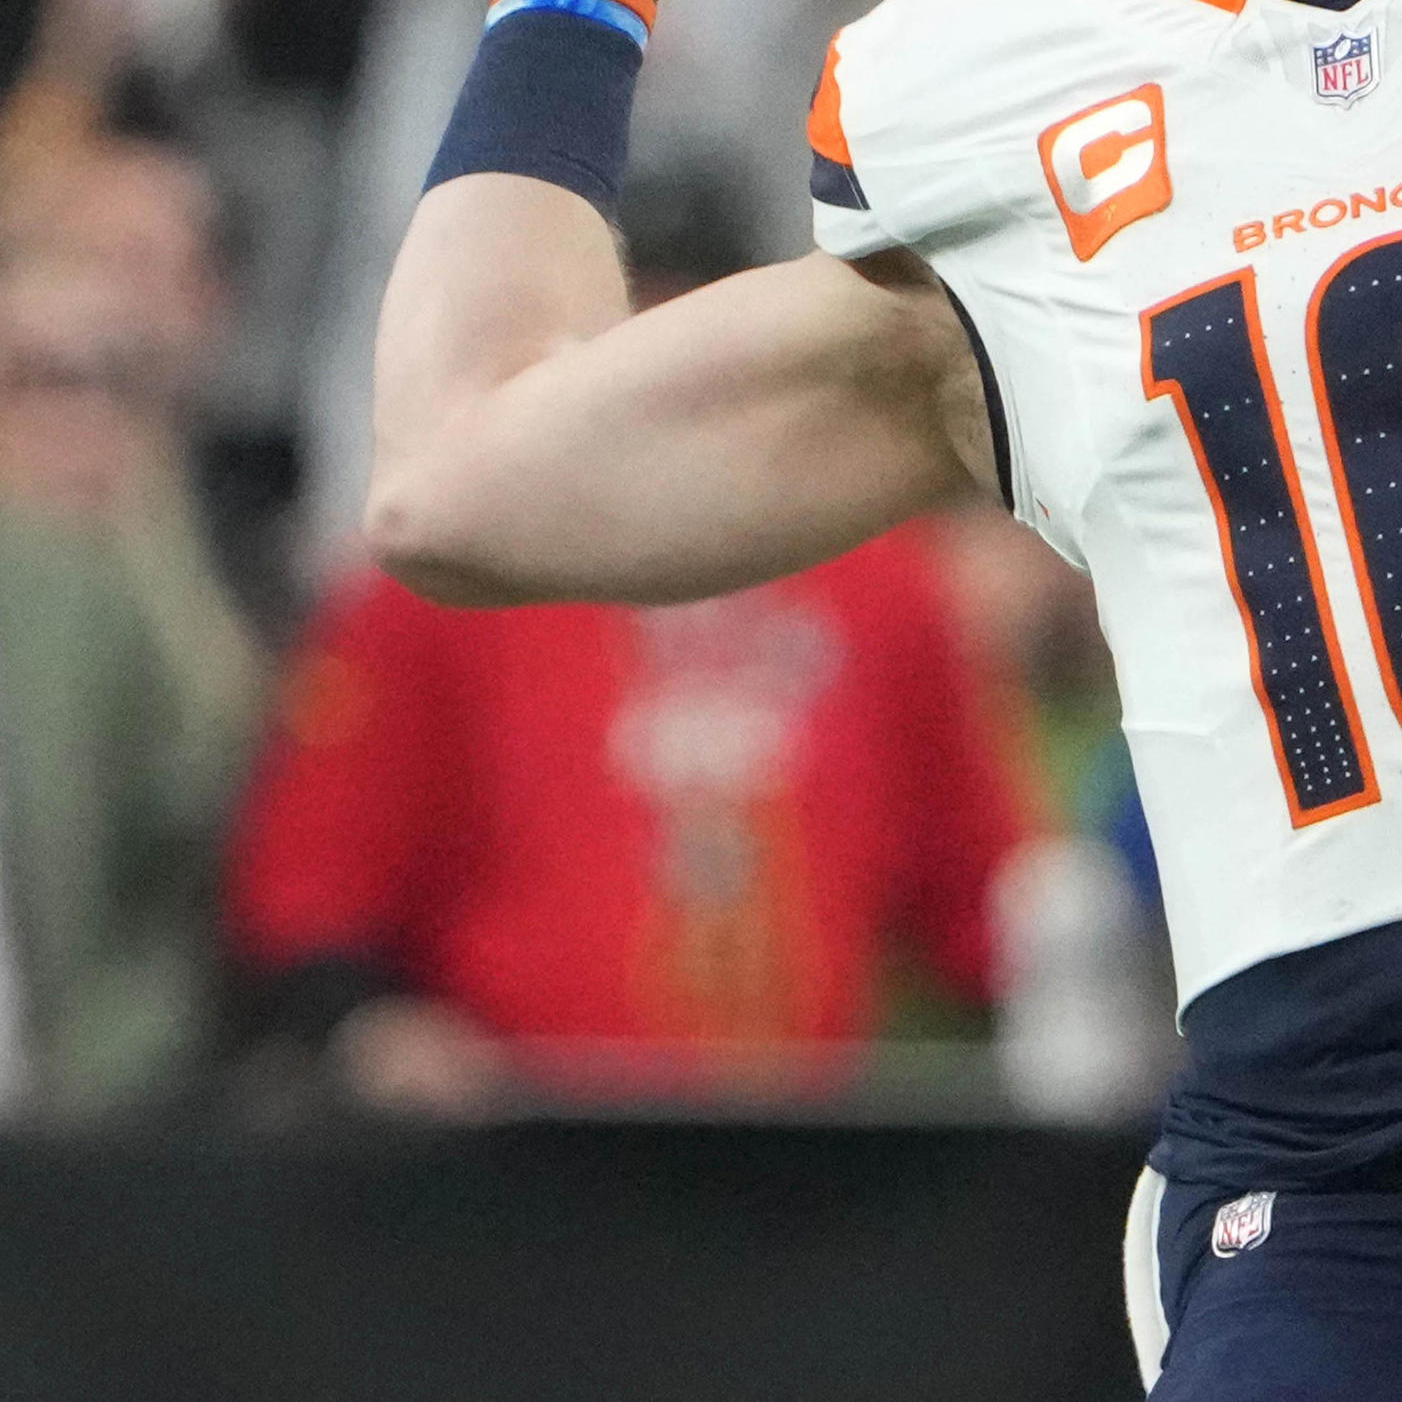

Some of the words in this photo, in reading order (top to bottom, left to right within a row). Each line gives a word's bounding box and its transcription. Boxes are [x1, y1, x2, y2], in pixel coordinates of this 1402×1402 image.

[1321, 59, 1370, 91] NFL
[1052, 99, 1154, 215] C
[1218, 1209, 1261, 1246] NFL
